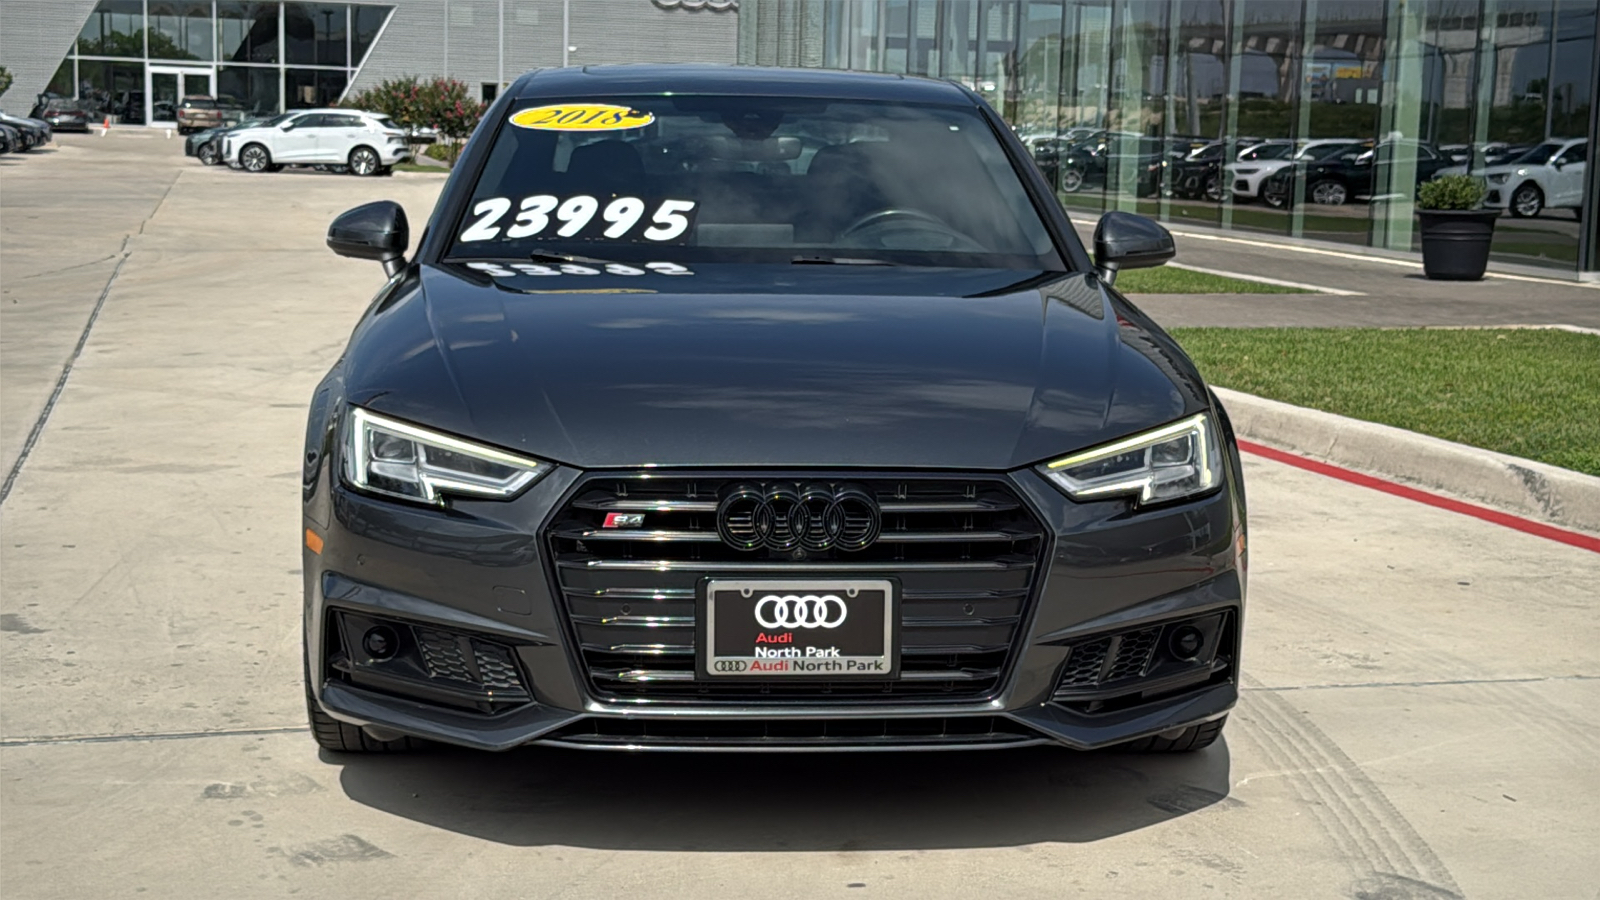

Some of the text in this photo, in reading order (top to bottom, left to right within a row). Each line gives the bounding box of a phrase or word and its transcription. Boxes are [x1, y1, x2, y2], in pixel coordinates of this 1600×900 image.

[533, 109, 624, 126] 2018
[460, 194, 696, 242] 23995
[756, 632, 793, 643] Audi
[755, 646, 841, 658] North Park
[750, 660, 884, 671] Audi North Park
